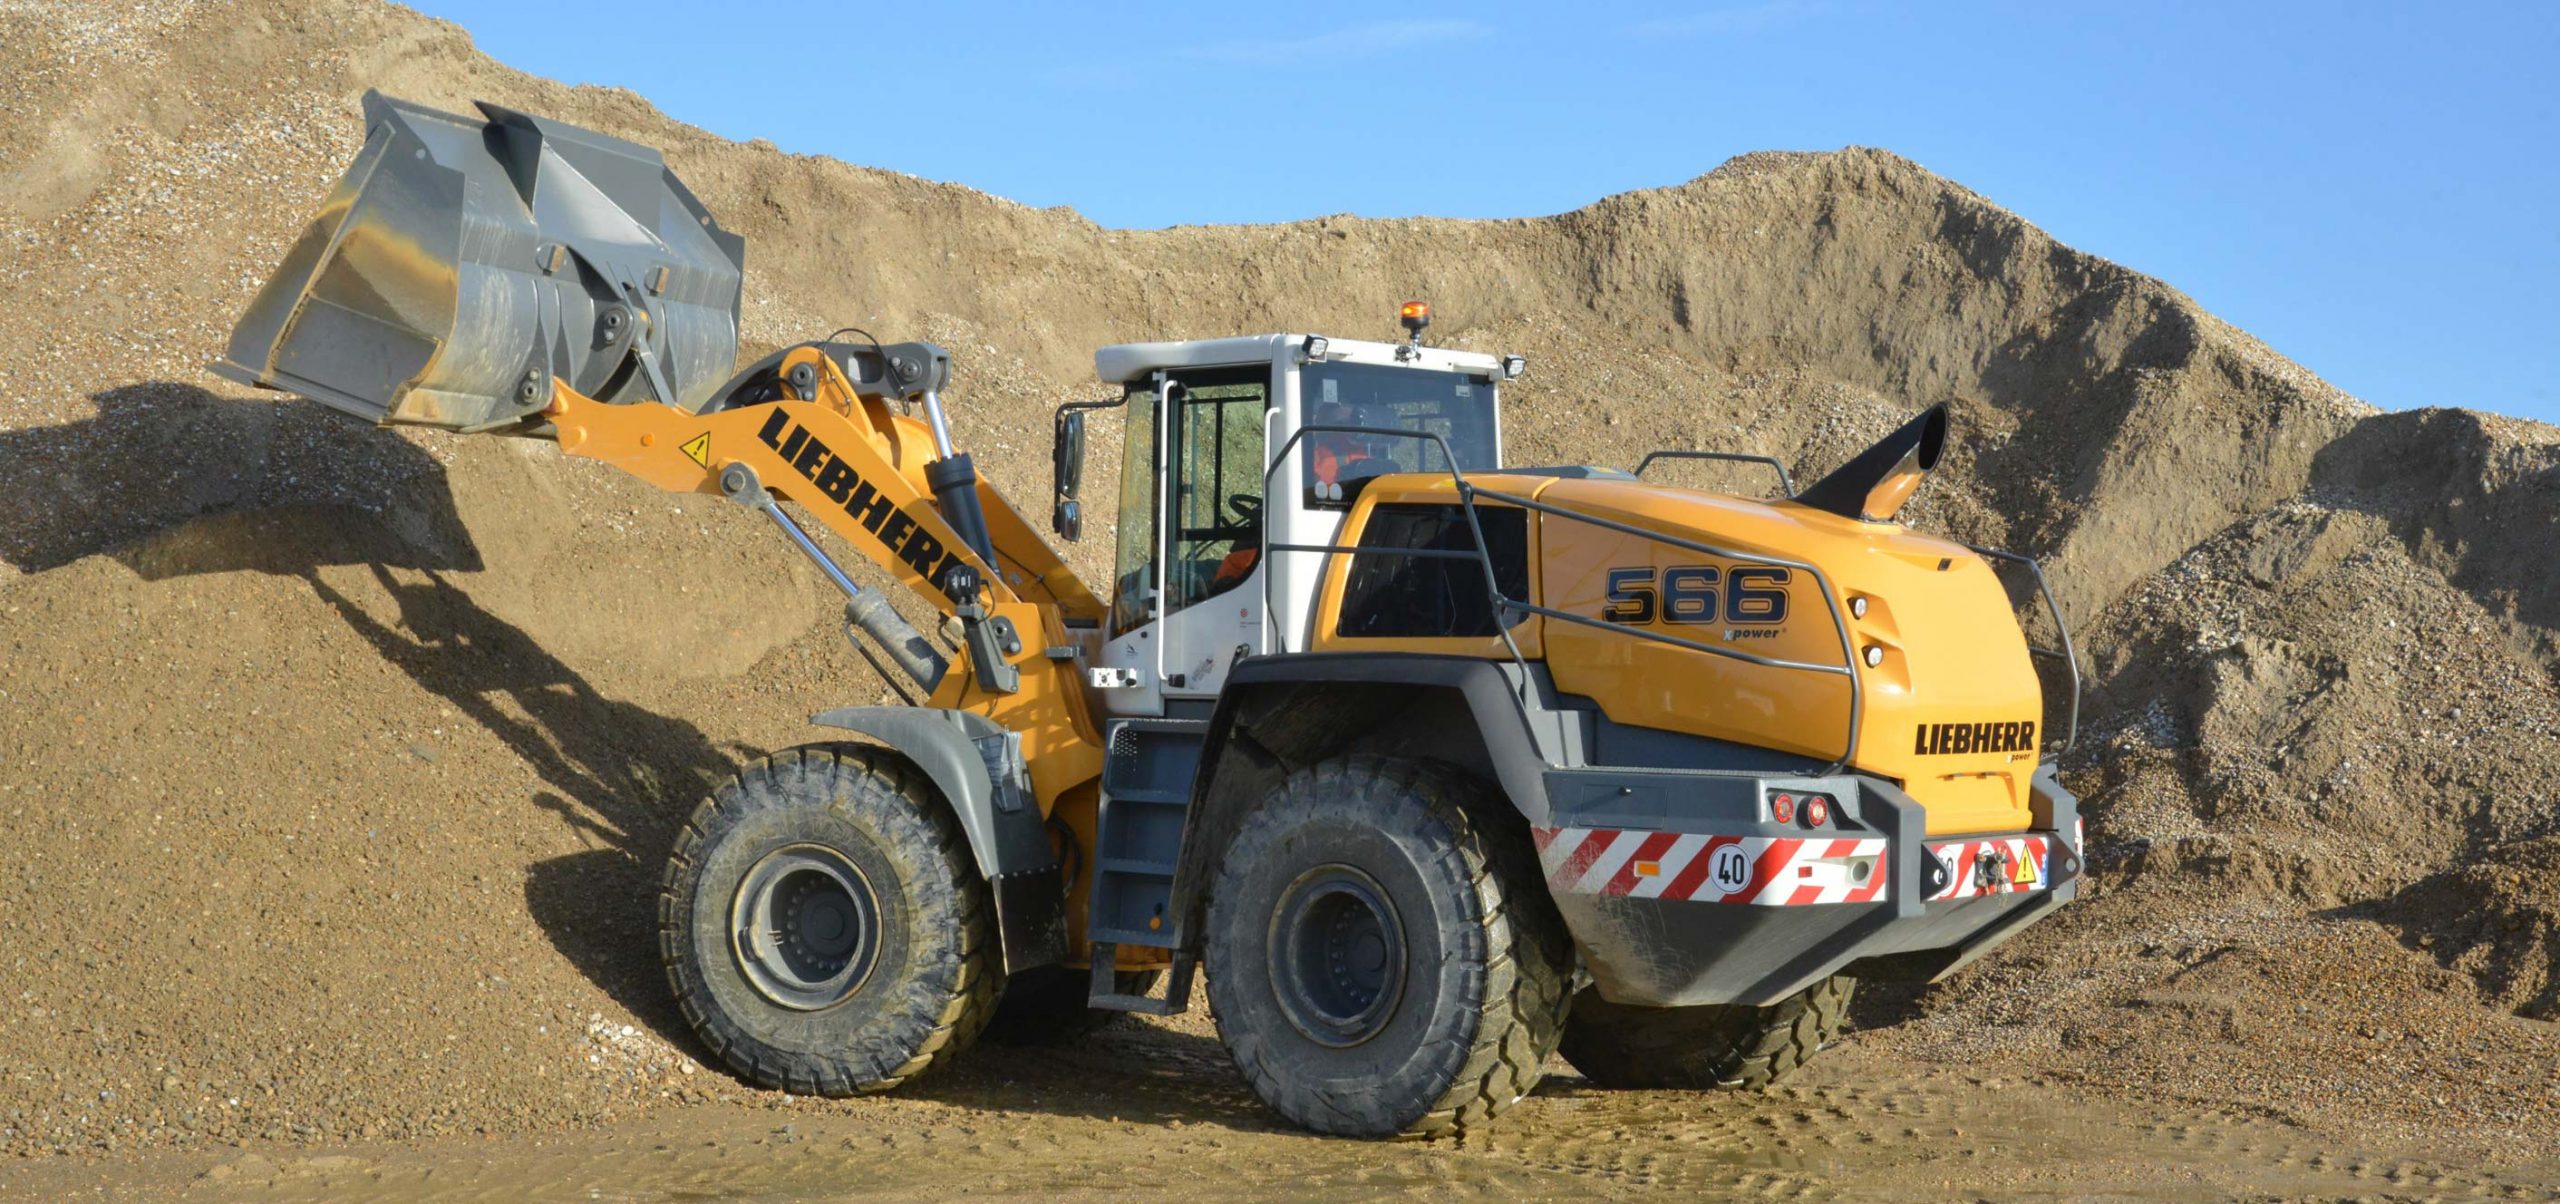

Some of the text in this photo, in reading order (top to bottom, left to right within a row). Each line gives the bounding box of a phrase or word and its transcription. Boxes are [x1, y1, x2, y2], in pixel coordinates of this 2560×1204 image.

[1602, 565, 1792, 625] 566
[1914, 721, 2035, 755] LIEBHERR
[1718, 853, 1745, 885] 40
